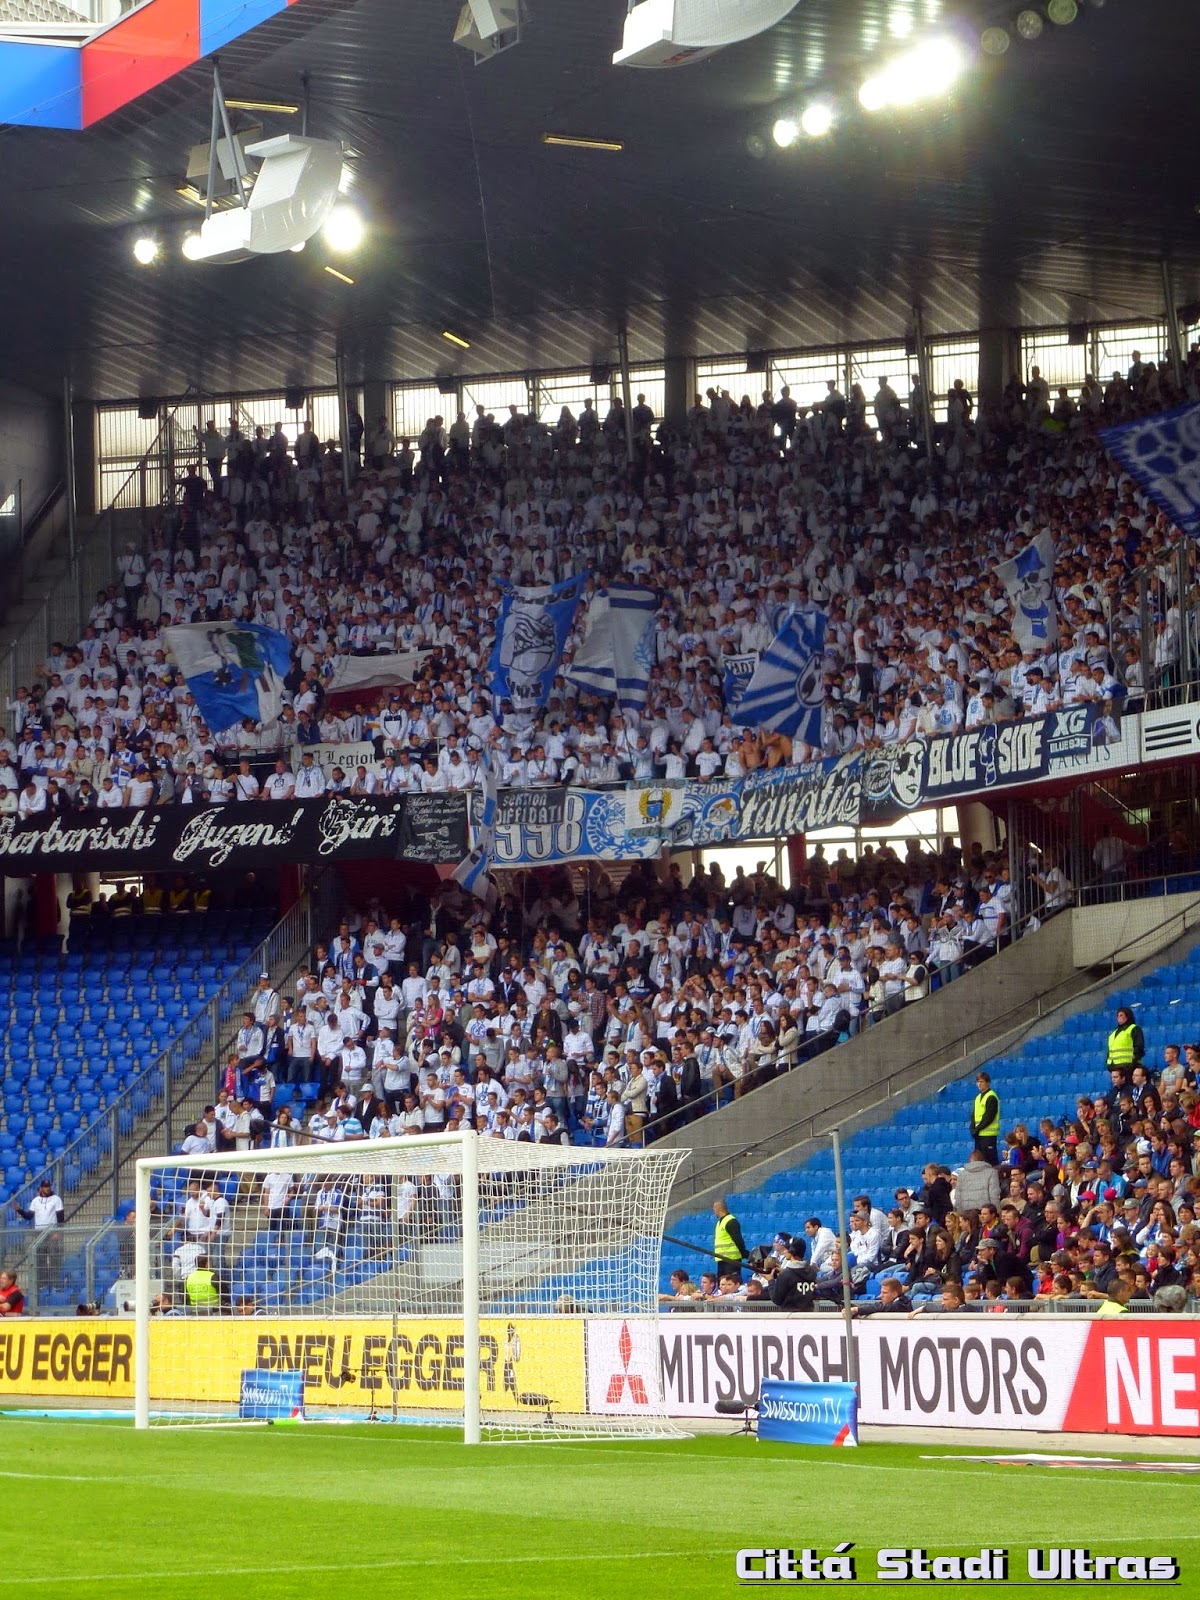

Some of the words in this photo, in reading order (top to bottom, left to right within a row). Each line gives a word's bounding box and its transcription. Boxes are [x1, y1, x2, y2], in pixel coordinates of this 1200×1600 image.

[326, 750, 378, 769] Legion
[927, 732, 980, 787] BLUE
[998, 720, 1046, 775] SIDE
[31, 1333, 133, 1382] EGGER
[254, 1334, 353, 1389] PNEU
[360, 1333, 499, 1392] EGGER
[659, 1334, 862, 1409] MITSUBISHI
[879, 1336, 1048, 1416] MOTORS
[1104, 1336, 1199, 1427] NE
[761, 1393, 821, 1423] Swisscom
